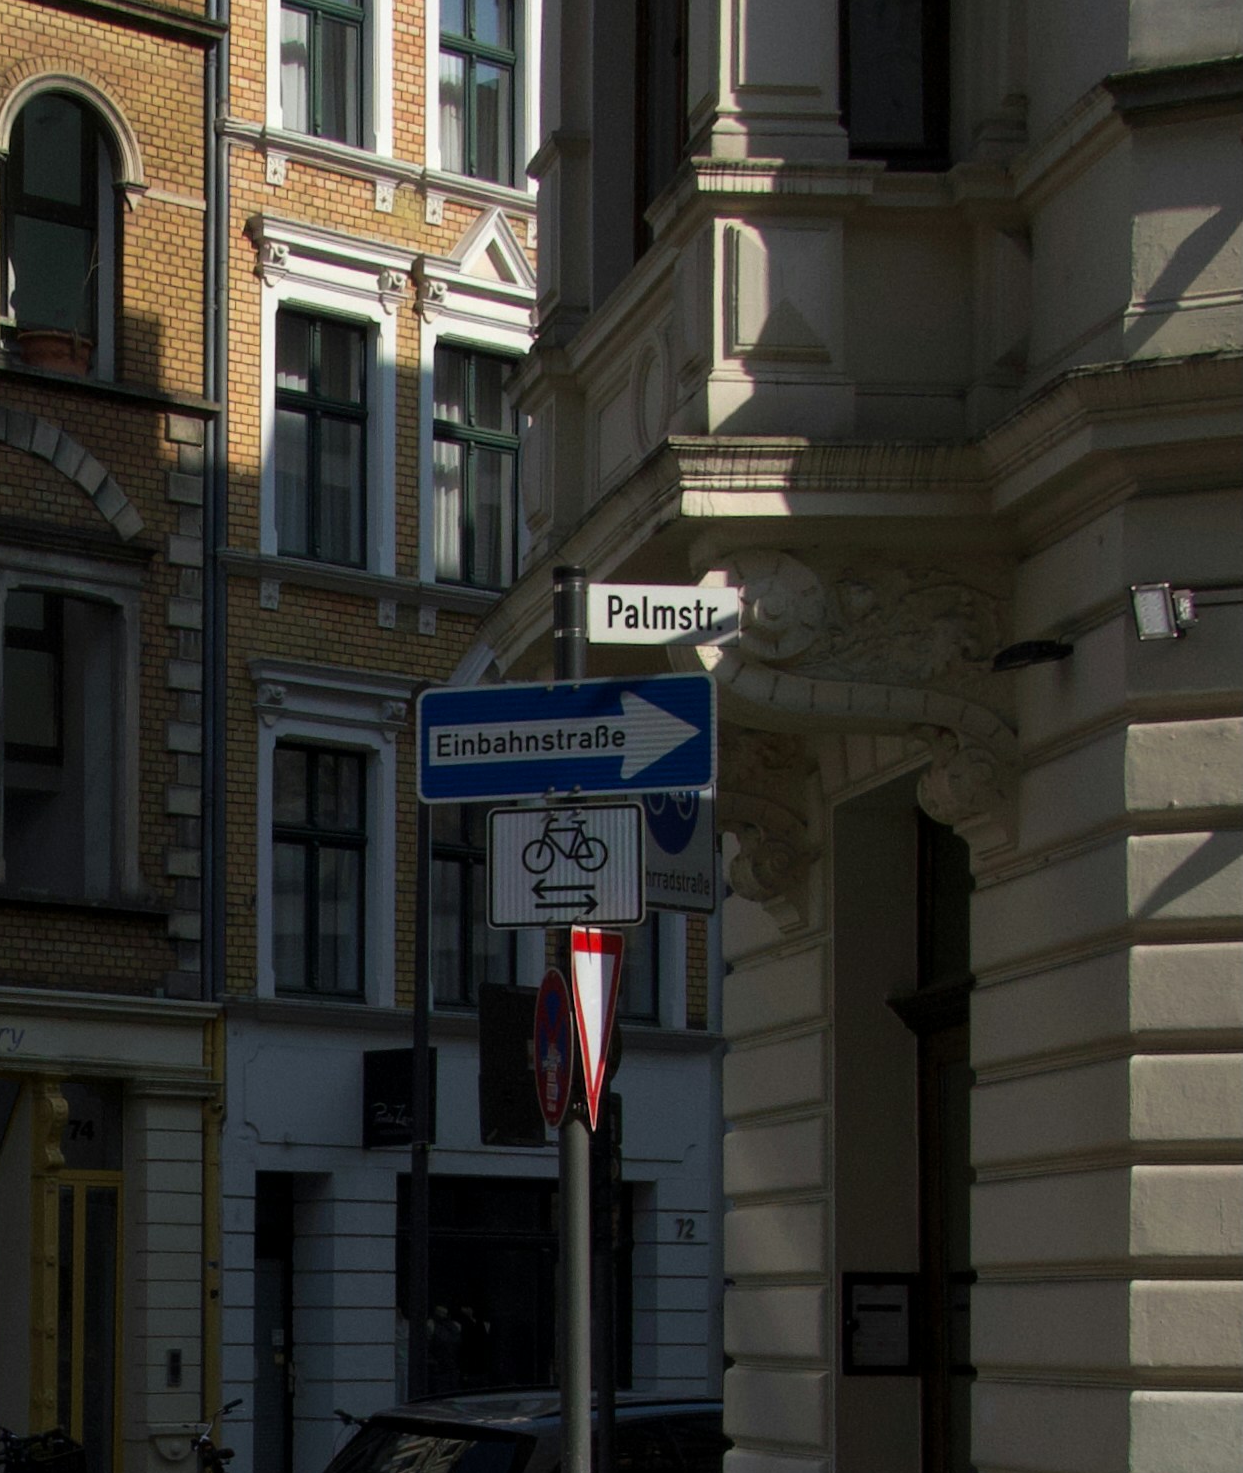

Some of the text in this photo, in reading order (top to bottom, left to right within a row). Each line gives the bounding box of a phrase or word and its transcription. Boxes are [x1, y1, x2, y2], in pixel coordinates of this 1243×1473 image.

[606, 594, 723, 632] Palmstr.
[436, 725, 627, 758] Einbahnstraße
[69, 1120, 95, 1141] 74
[675, 1218, 695, 1239] 72
